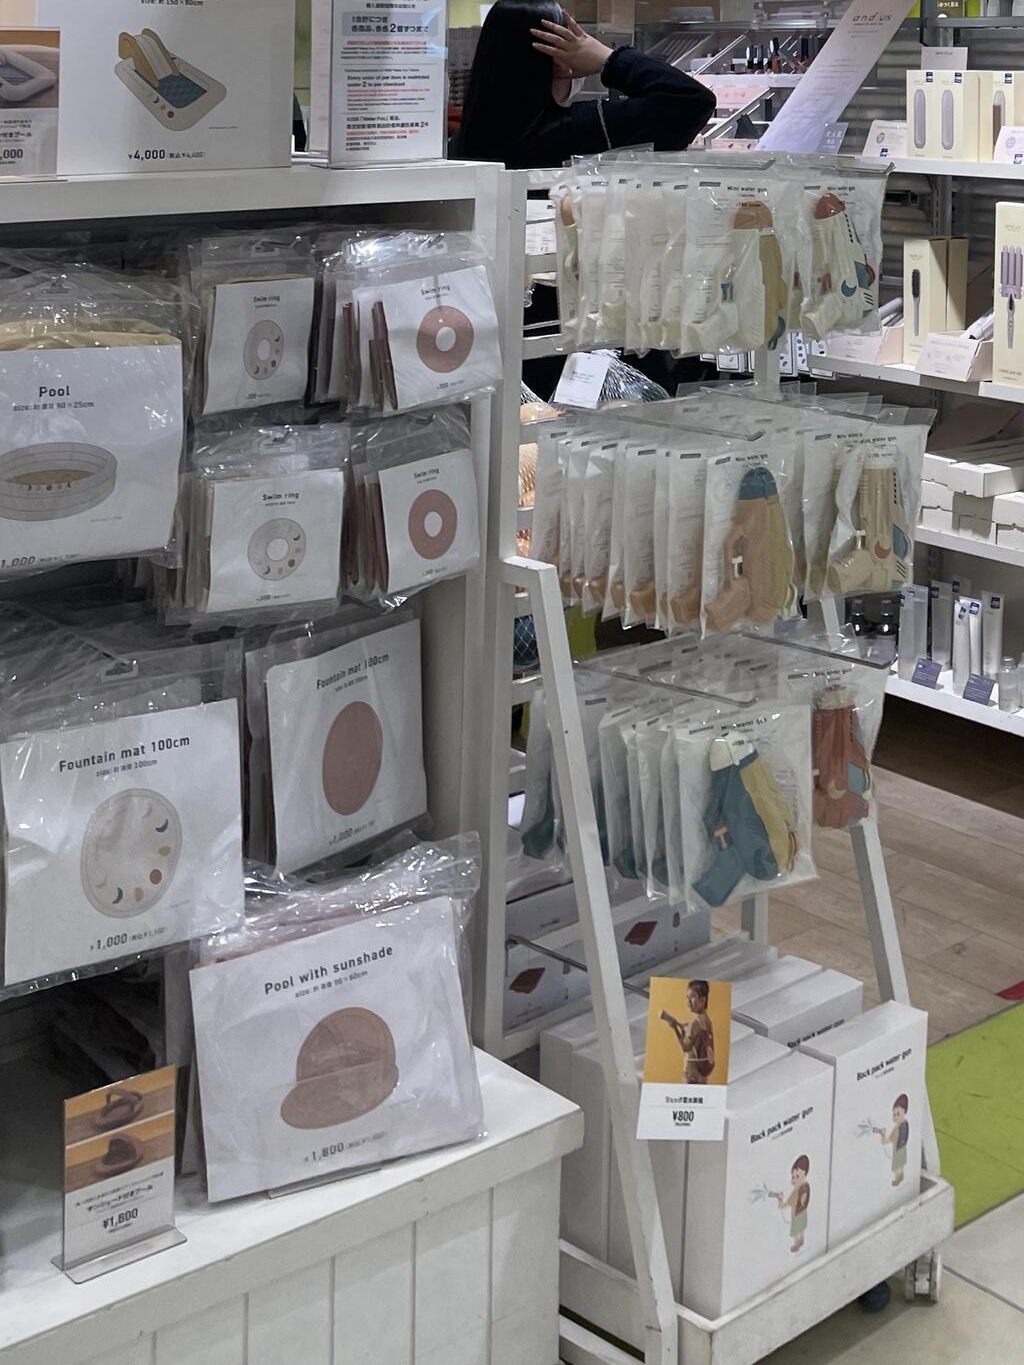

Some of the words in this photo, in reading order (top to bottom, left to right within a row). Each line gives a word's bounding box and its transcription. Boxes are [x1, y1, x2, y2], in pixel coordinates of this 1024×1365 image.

[852, 12, 878, 22] and
[879, 14, 892, 22] us
[128, 149, 166, 161] ¥4,000
[39, 385, 70, 398] Pool
[316, 670, 346, 690] Fountain
[347, 663, 361, 676] mat
[364, 654, 389, 670] 100cm
[59, 751, 116, 773] Fountain
[120, 744, 146, 760] mat
[151, 736, 190, 753] 100cm
[264, 975, 294, 994] Pool
[299, 965, 328, 984] with
[333, 945, 393, 974] sunshade
[856, 1068, 870, 1081] Back
[871, 1061, 884, 1075] pack
[885, 1053, 901, 1066] water
[902, 1048, 912, 1061] gun
[672, 1110, 695, 1122] ¥800
[750, 1130, 766, 1144] Back
[767, 1121, 781, 1137] pack
[783, 1112, 800, 1126] water
[802, 1106, 813, 1119] gun
